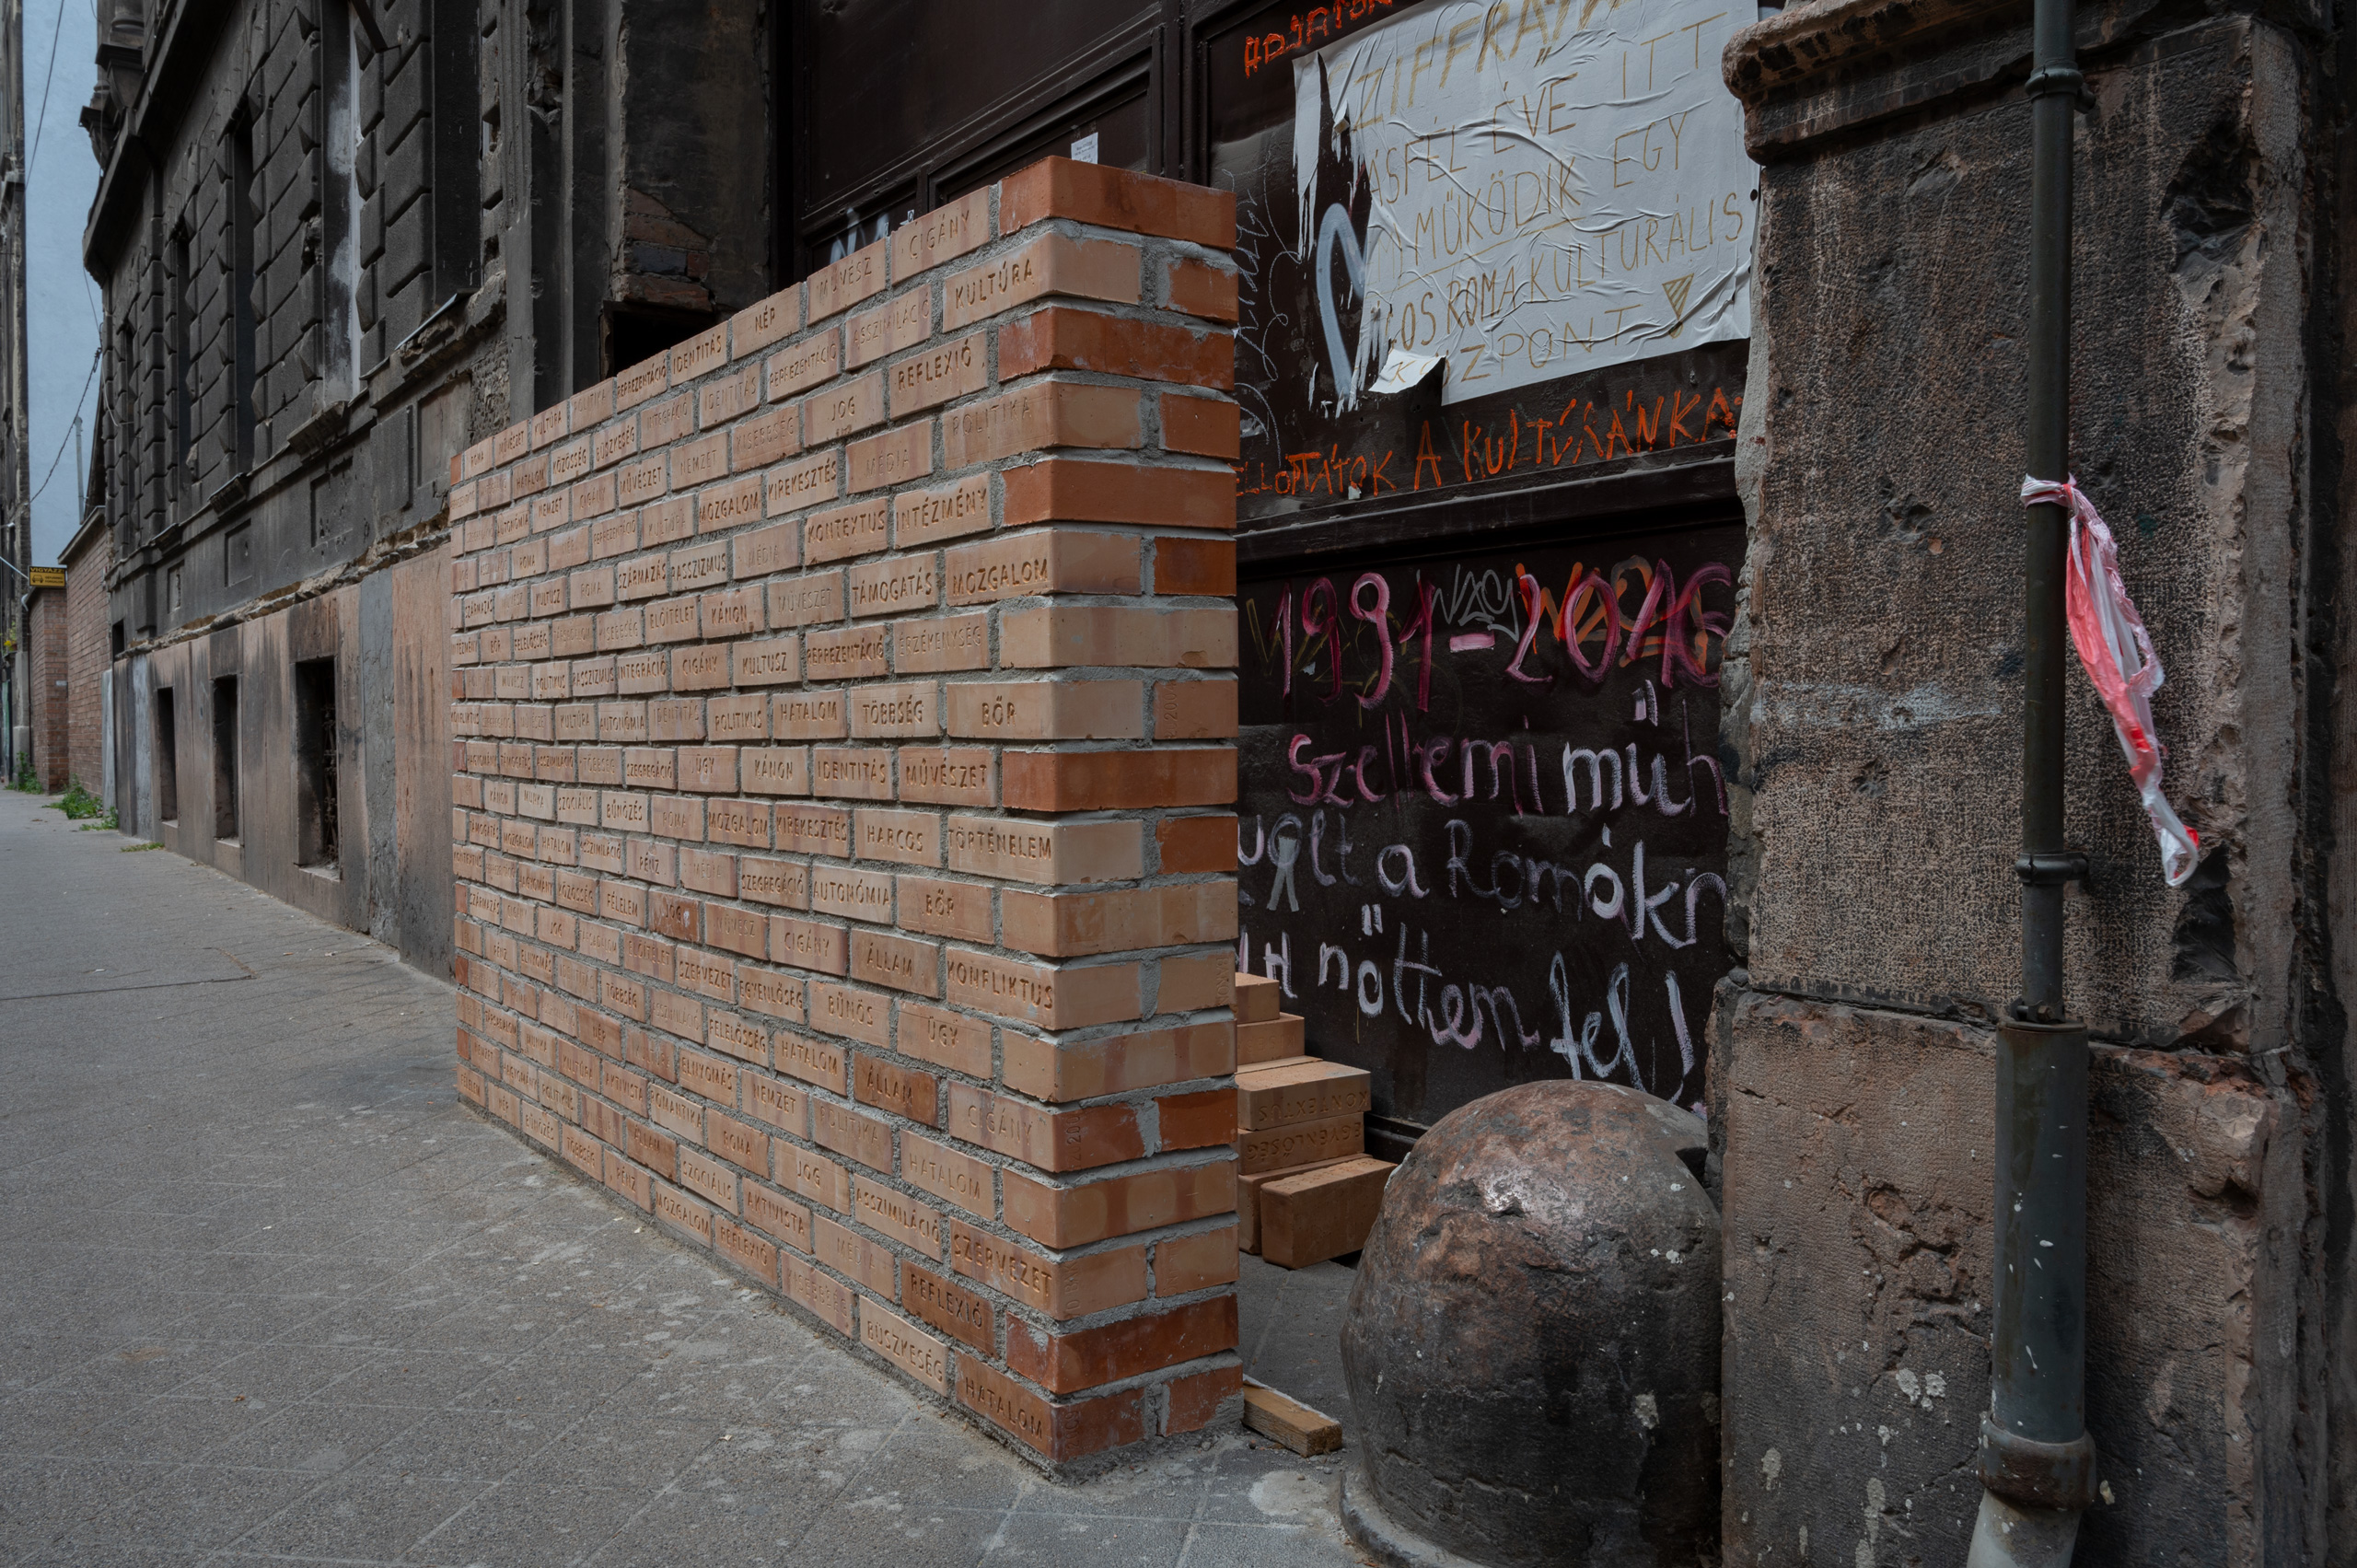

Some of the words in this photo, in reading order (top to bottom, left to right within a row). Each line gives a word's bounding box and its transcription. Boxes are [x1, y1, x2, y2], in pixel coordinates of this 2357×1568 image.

[1368, 117, 1468, 208] ÁSFÉL
[1622, 12, 1727, 99] ITT
[1613, 110, 1688, 190] EGY
[955, 250, 1033, 312] KULTÚRA
[1446, 265, 1516, 334] ROMA
[755, 302, 774, 336] NÉP
[673, 331, 721, 375] IDENTITÁS
[898, 337, 971, 392] REFLEXIÓ
[617, 358, 666, 401] REPREZENTÁCIÓ
[704, 369, 756, 412] IDENTITÁS
[831, 396, 854, 423] JOG
[952, 394, 1032, 440] POLITIKA
[1413, 421, 1442, 491] A
[1464, 388, 1745, 482] KULTÚRÁNKA
[680, 448, 715, 475] NEMZET
[768, 457, 836, 503] KIREKESZTÉS
[539, 496, 562, 518] NEMZET
[699, 487, 758, 524] MOZGALOM
[896, 482, 987, 532] INTÉZMÉNY
[807, 508, 886, 546] KONTEXTUS
[618, 558, 666, 589] SZÁRMAZÁS
[671, 552, 726, 583] RASSZIZMUS
[853, 564, 932, 606] TÁMOGATÁS
[953, 557, 1048, 598] MOZGALOM
[711, 598, 747, 626] KÁNON
[617, 655, 666, 680] INTEGRÁCIÓ
[682, 649, 717, 677] CIGÁNY
[742, 650, 787, 675] KULTUSZ
[808, 634, 883, 667] REPREZENTÁCIÓ
[599, 712, 644, 732] AUTONÓMIA
[714, 709, 761, 731] POLITIKUS
[781, 702, 836, 723] HATALOM
[862, 694, 923, 725] TÖBBSÉG
[981, 698, 1016, 728] BŐR
[754, 753, 793, 780] KÁNON
[818, 757, 885, 784] IDENTITÁS
[558, 791, 591, 813] SZOCIÁLIS
[708, 811, 767, 838] MOZGALOM
[776, 809, 847, 843] KIREKESZTÉS
[867, 824, 923, 854] HARCOS
[541, 835, 570, 854] HATALOM
[948, 825, 1051, 862] TÖRTÉNELEM
[639, 851, 659, 875] PÉNZ
[1378, 843, 1431, 899] a
[741, 865, 803, 900] SZEGREGÁCIÓ
[813, 871, 889, 912] AUTONÓMIA
[607, 889, 637, 918] FÉLELEM
[665, 902, 681, 923] JOG
[925, 887, 954, 919] BŐR
[550, 920, 562, 937] JOG
[784, 923, 830, 959] CIGÁNY
[679, 958, 732, 993] SZERVEZET
[866, 941, 911, 979] ÁLLAM
[606, 979, 636, 1009] TÖBBSÉG
[739, 971, 802, 1015] EGYENLŐSÉG
[946, 959, 1053, 1010] KONFLIKTUS
[709, 1012, 765, 1056] FELELŐSSÉG
[681, 1051, 732, 1094] ELNYOMÁS
[782, 1038, 837, 1077] HATALOM
[605, 1071, 643, 1103] AKTIVISTA
[753, 1081, 795, 1118] NEMZET
[866, 1063, 911, 1107] ÁLLAM
[650, 1089, 701, 1131] ROMANTIKA
[969, 1096, 1031, 1149] CIGÁNY
[1259, 1090, 1368, 1122] KONTEXTUS
[820, 1104, 878, 1147] POLITIKA
[1246, 1121, 1362, 1161] EGYENLŐSÉG
[723, 1129, 750, 1160] ROMA
[616, 1161, 635, 1194] PÉNZ
[682, 1156, 731, 1202] SZOCIÁLIS
[796, 1159, 819, 1189] JOG
[910, 1151, 980, 1202] HATALOM
[656, 1191, 708, 1238] MOZGALOM
[748, 1190, 805, 1239] AKTIVISTA
[855, 1182, 939, 1246] ASSZIMILÁCIÓ
[720, 1220, 767, 1269] REFLEXIÓ
[954, 1229, 1051, 1303] SZERVEZET
[911, 1268, 982, 1331] REFLEXIÓ
[867, 1313, 942, 1384] BÜSZKESÉG
[966, 1376, 1041, 1441] HATALOM
